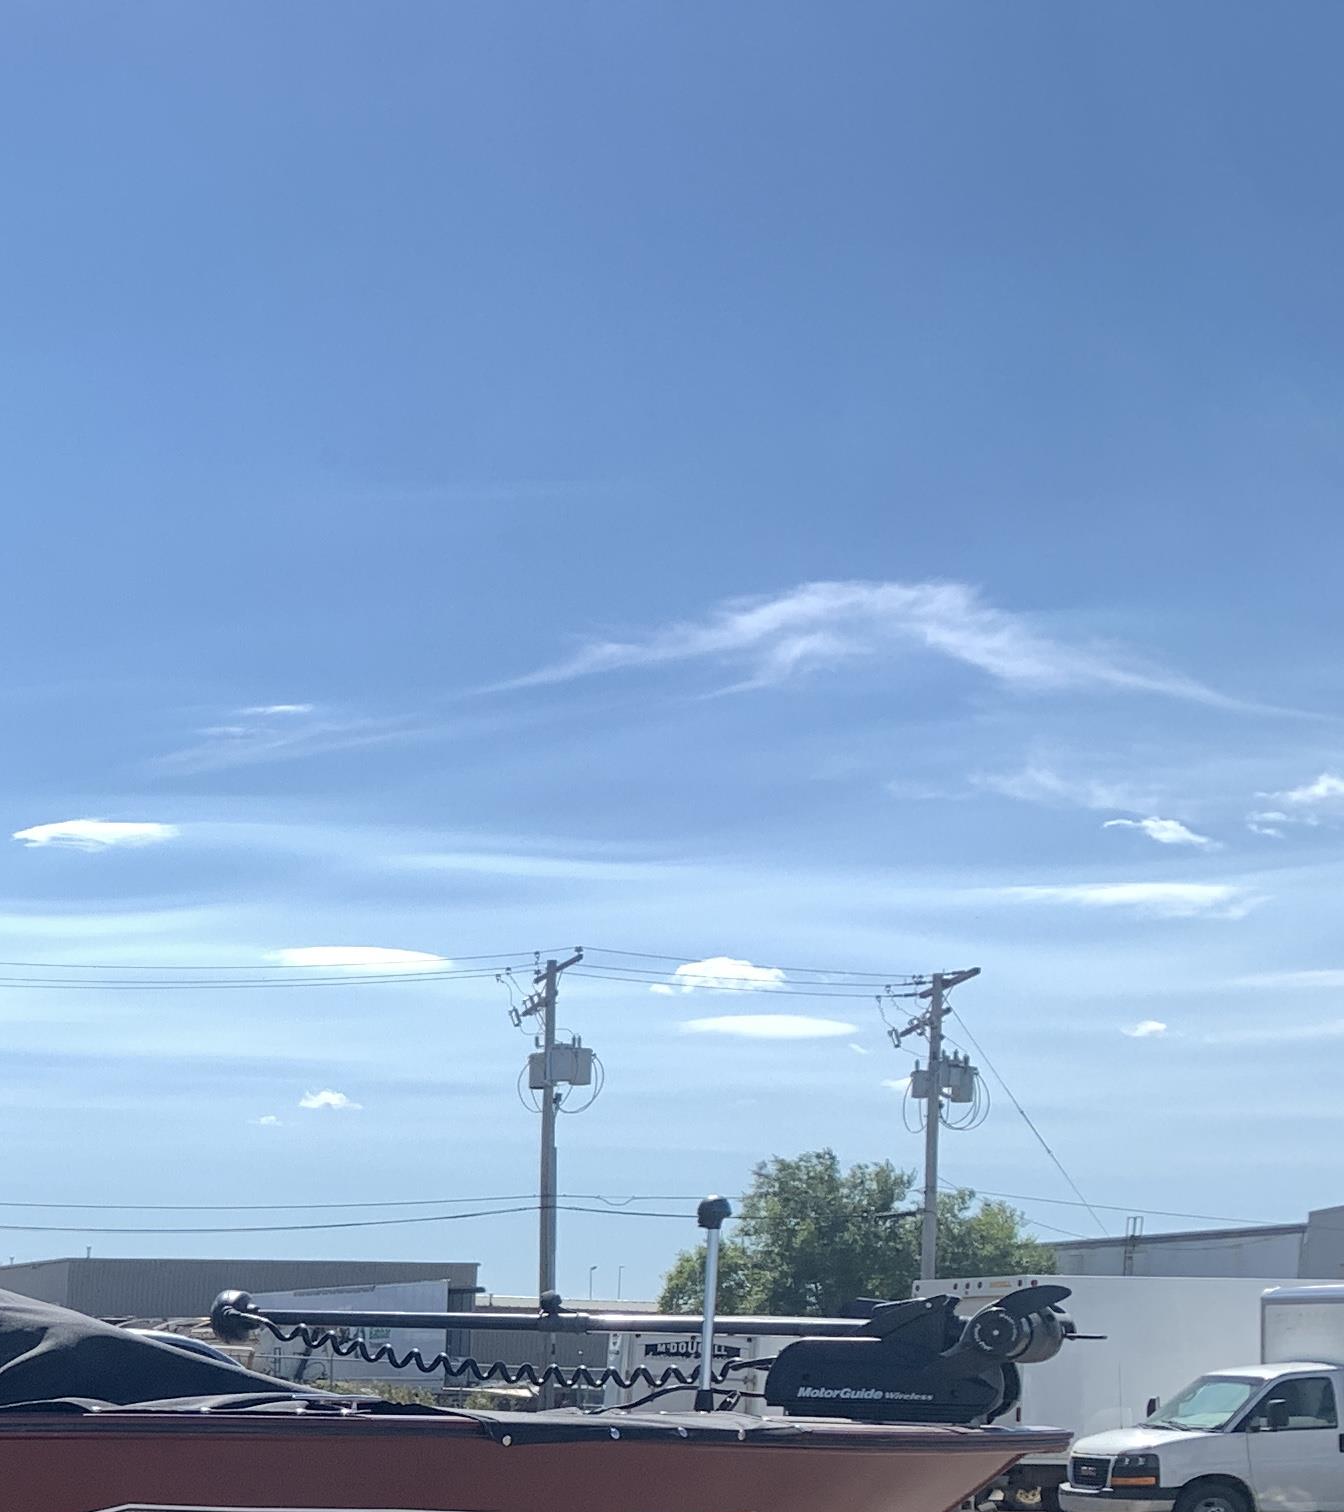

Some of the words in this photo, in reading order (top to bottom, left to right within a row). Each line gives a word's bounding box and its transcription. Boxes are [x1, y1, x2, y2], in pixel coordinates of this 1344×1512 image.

[657, 1340, 728, 1355] McDOULL
[797, 1386, 883, 1400] MotorGuide
[885, 1391, 934, 1401] Wireless
